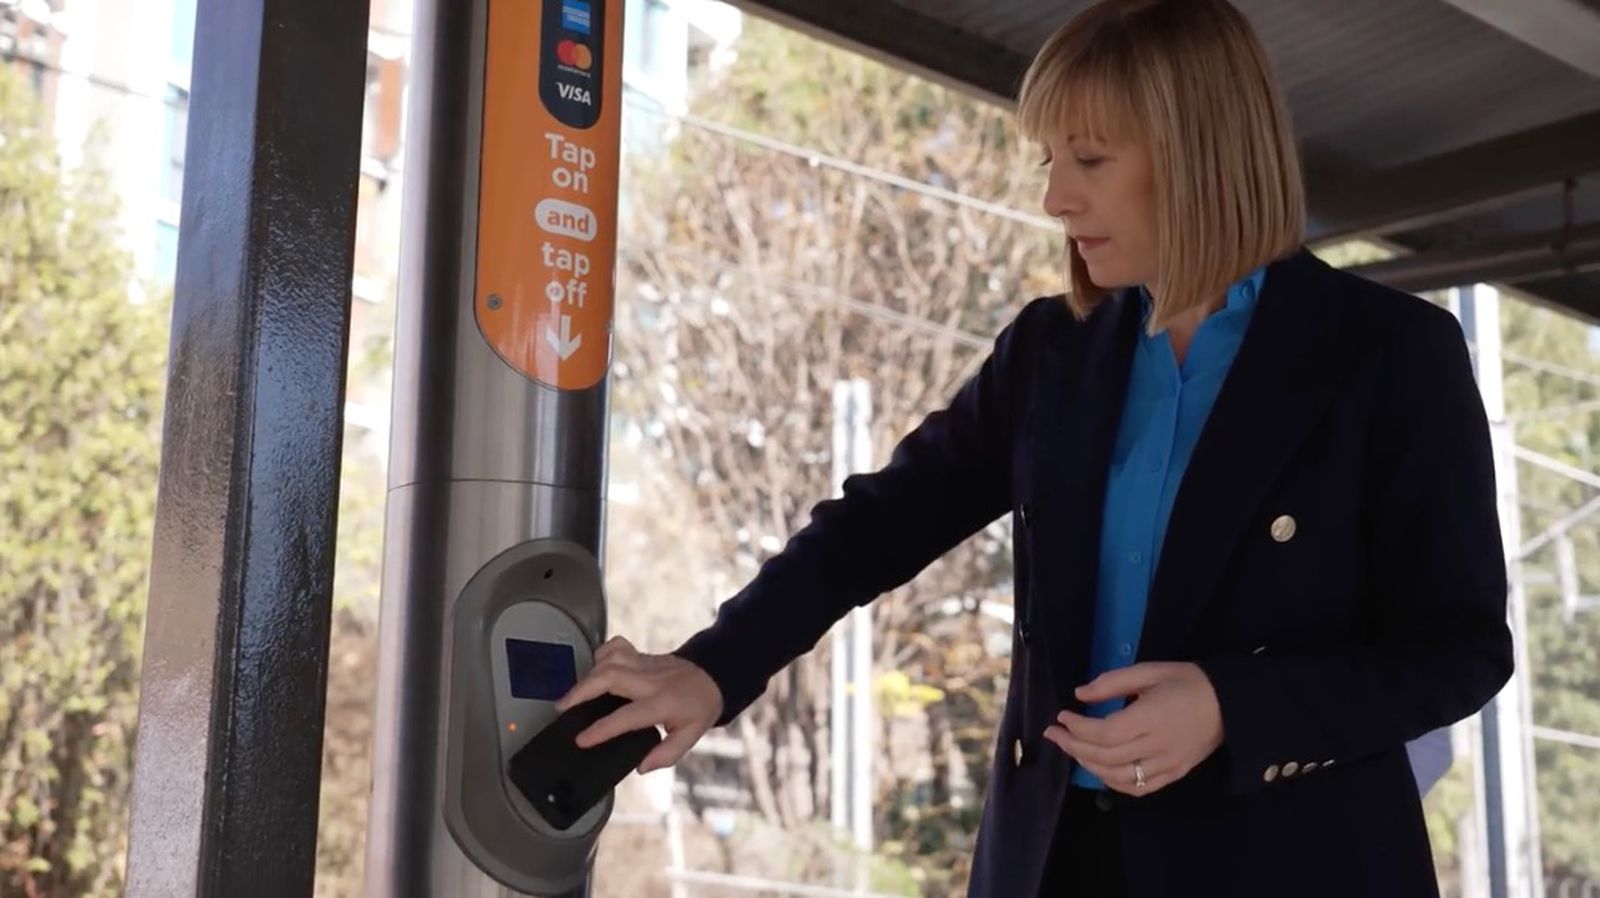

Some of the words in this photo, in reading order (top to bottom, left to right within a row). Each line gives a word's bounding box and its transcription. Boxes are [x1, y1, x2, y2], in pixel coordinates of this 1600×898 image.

[556, 82, 592, 106] VISA
[545, 133, 596, 170] Tap
[552, 167, 588, 193] on
[547, 210, 589, 234] and
[542, 242, 590, 277] tap
[546, 280, 587, 308] off
